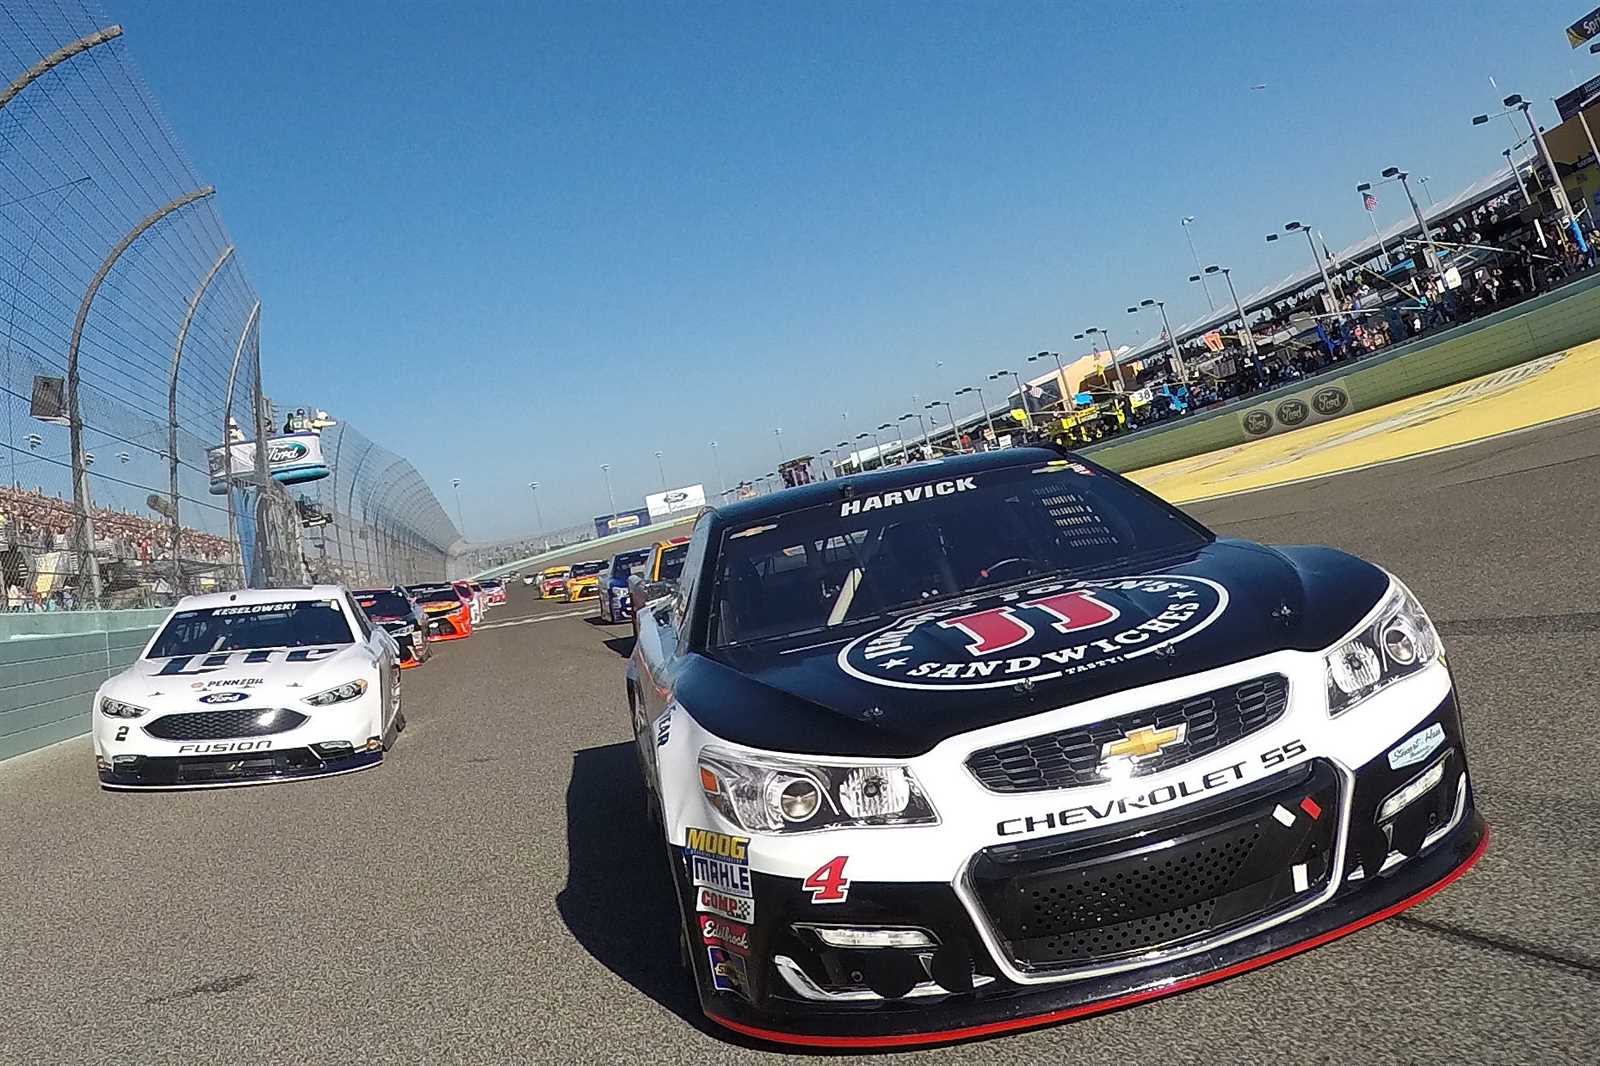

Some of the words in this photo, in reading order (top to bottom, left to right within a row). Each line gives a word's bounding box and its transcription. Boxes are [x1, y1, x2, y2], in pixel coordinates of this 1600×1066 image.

[1313, 392, 1341, 410] Ford
[1281, 404, 1303, 421] Ford
[840, 476, 978, 518] HARVICK
[211, 602, 297, 616] KESELOWSKI
[906, 602, 1200, 680] SANDWICHES
[207, 678, 264, 688] PENNZOIL
[207, 692, 240, 704] Ford
[115, 725, 130, 742] 2
[178, 740, 272, 754] FUSION
[996, 760, 1248, 836] CHEVROLET
[1259, 738, 1308, 769] SS
[686, 829, 747, 859] MOOG
[694, 858, 750, 891] MAHLE
[802, 855, 849, 904] 4
[701, 890, 738, 912] COMP
